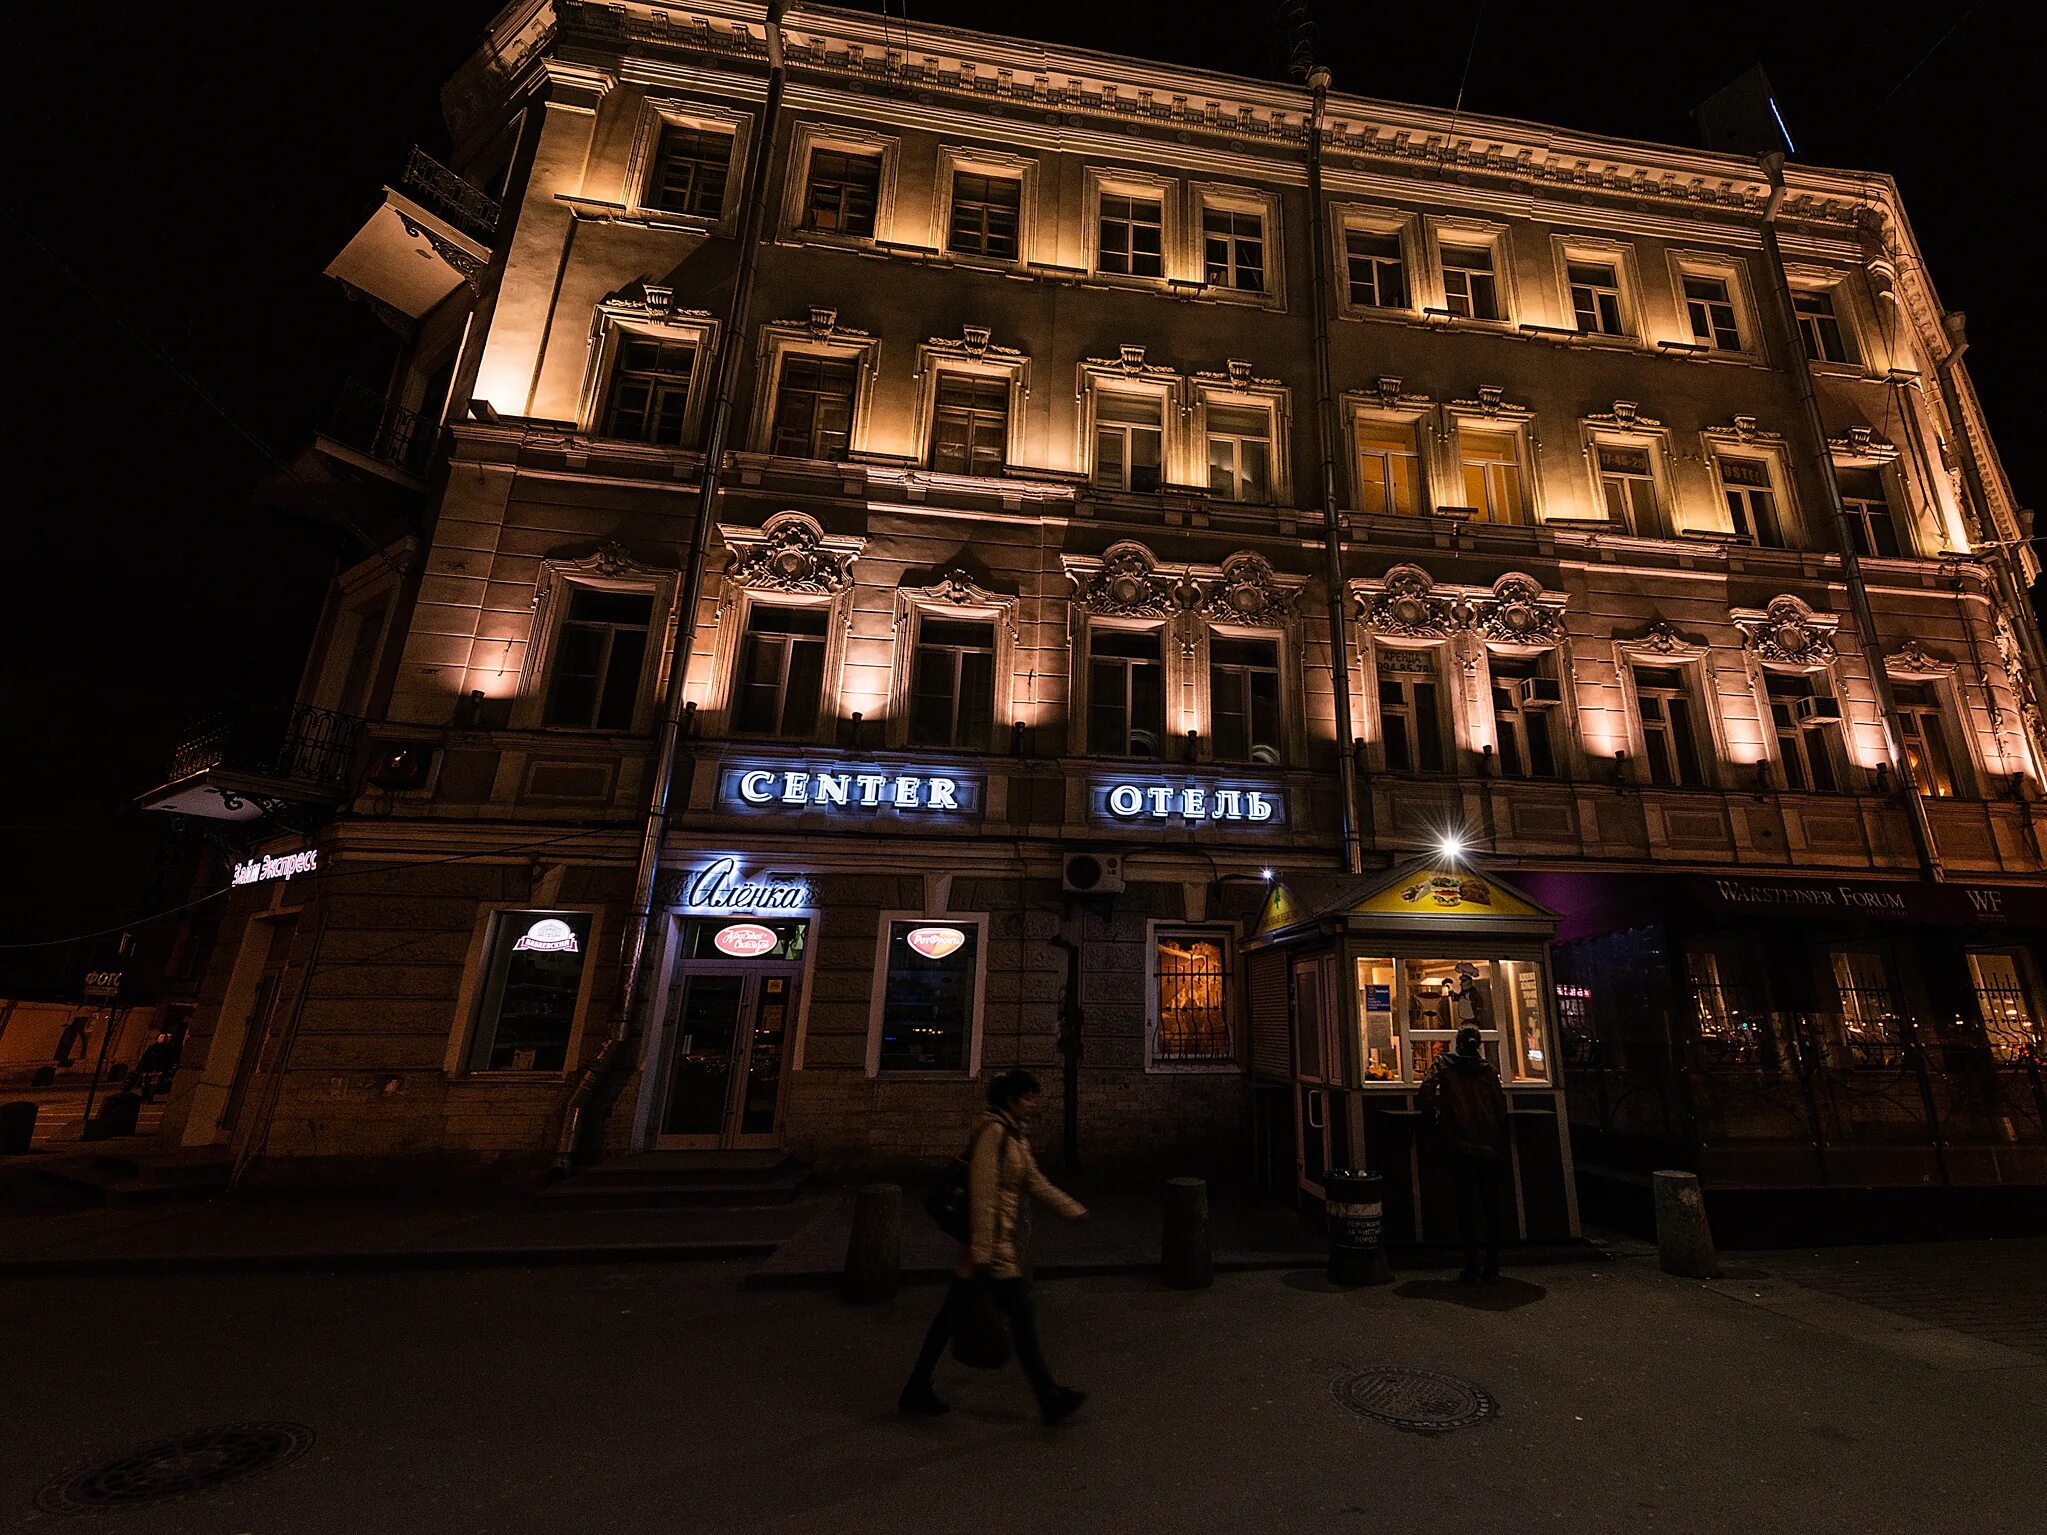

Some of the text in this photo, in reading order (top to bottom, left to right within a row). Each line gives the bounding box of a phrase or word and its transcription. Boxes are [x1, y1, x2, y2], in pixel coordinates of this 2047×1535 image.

[1383, 650, 1421, 663] АРЕНДА
[741, 770, 958, 809] CENTER
[1110, 785, 1272, 821] ОТЕЛЬ
[259, 849, 317, 881] Экспресс
[688, 857, 801, 908] Алёнка
[1715, 880, 1905, 909] WARSTEINER FORUM
[1965, 890, 2002, 912] WF
